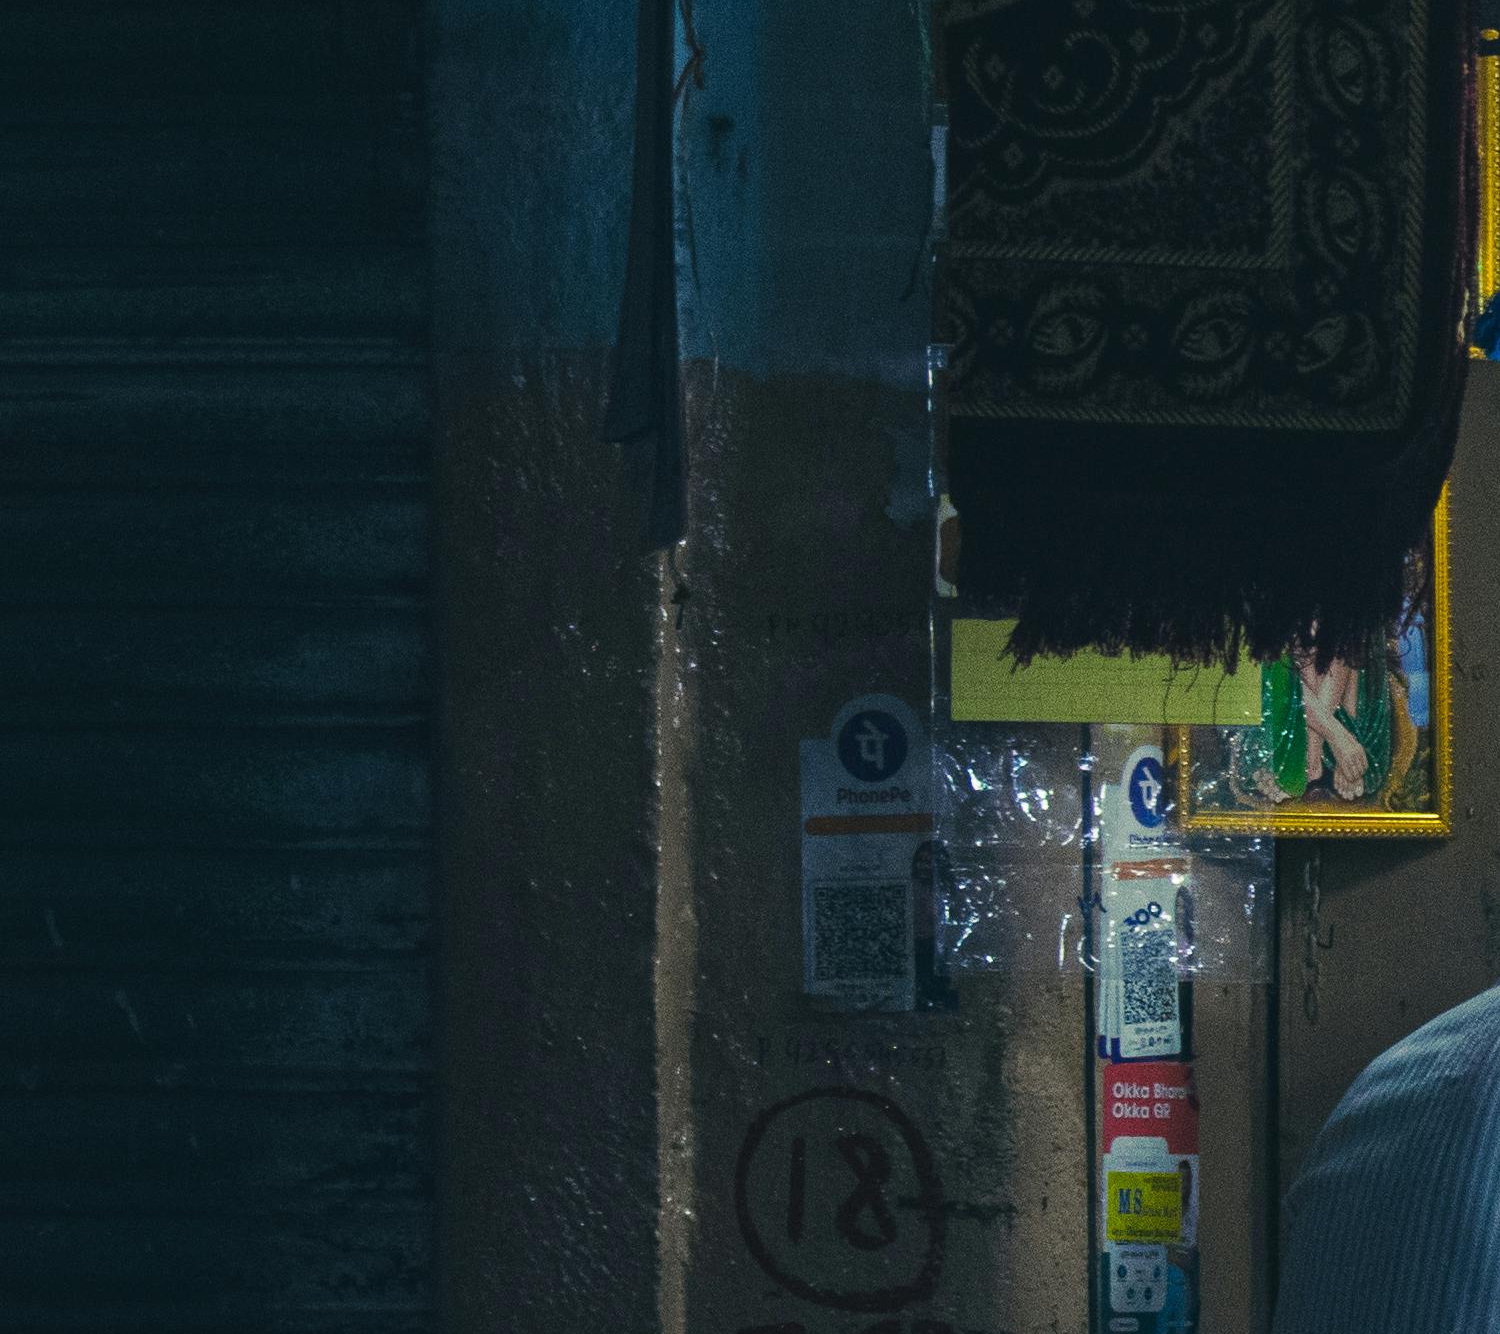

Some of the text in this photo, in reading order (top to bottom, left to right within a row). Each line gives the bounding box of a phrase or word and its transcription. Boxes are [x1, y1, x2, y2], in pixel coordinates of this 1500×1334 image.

[837, 787, 911, 804] PhonePe
[1112, 1082, 1150, 1098] Okka
[1112, 1102, 1150, 1119] Okka
[786, 1133, 899, 1251] 18
